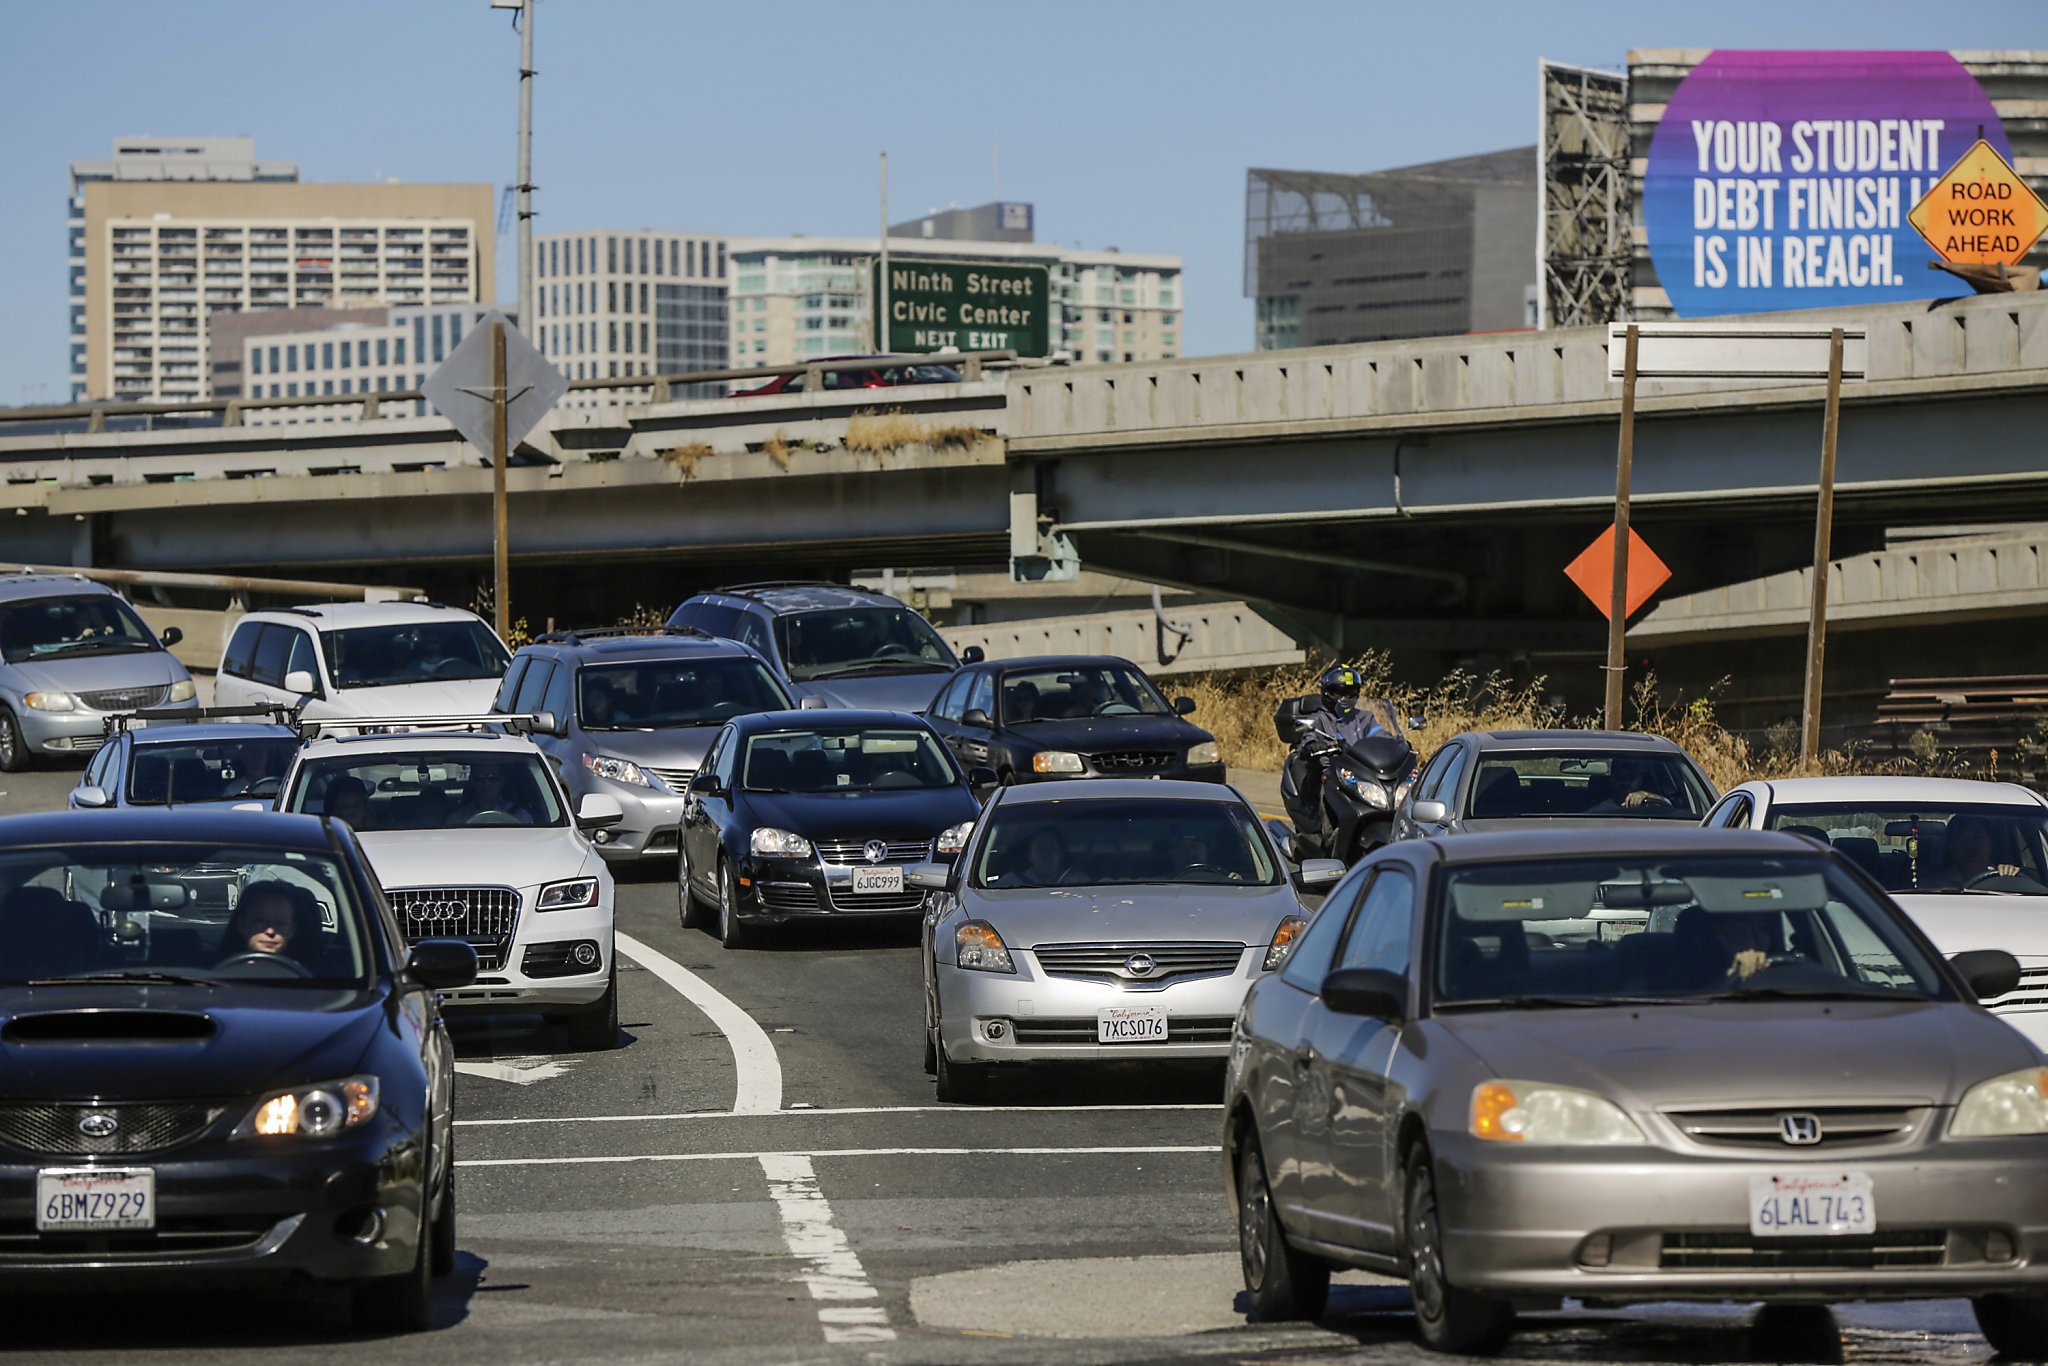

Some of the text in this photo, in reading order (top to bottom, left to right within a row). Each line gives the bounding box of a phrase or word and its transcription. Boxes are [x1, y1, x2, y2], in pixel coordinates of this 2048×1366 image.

[1691, 119, 1945, 174] YOUR STUDENT
[1952, 182, 2012, 200] ROAD
[1694, 177, 1780, 231] DEBT
[1788, 176, 1900, 231] FINISH
[1948, 208, 2015, 226] WORK
[1946, 235, 2020, 252] AHEAD
[1694, 234, 1904, 289] IS IN REACH.
[892, 270, 1033, 296] Ninth Street
[893, 301, 1031, 326] Civic Center
[915, 330, 1008, 349] NEXT EXIT
[857, 876, 900, 889] 6JGC999
[1111, 1009, 1154, 1019] California
[1102, 1018, 1163, 1037] 7XCS076
[46, 1192, 146, 1220] 6BMZ929
[1760, 1195, 1866, 1225] 6LAL743
